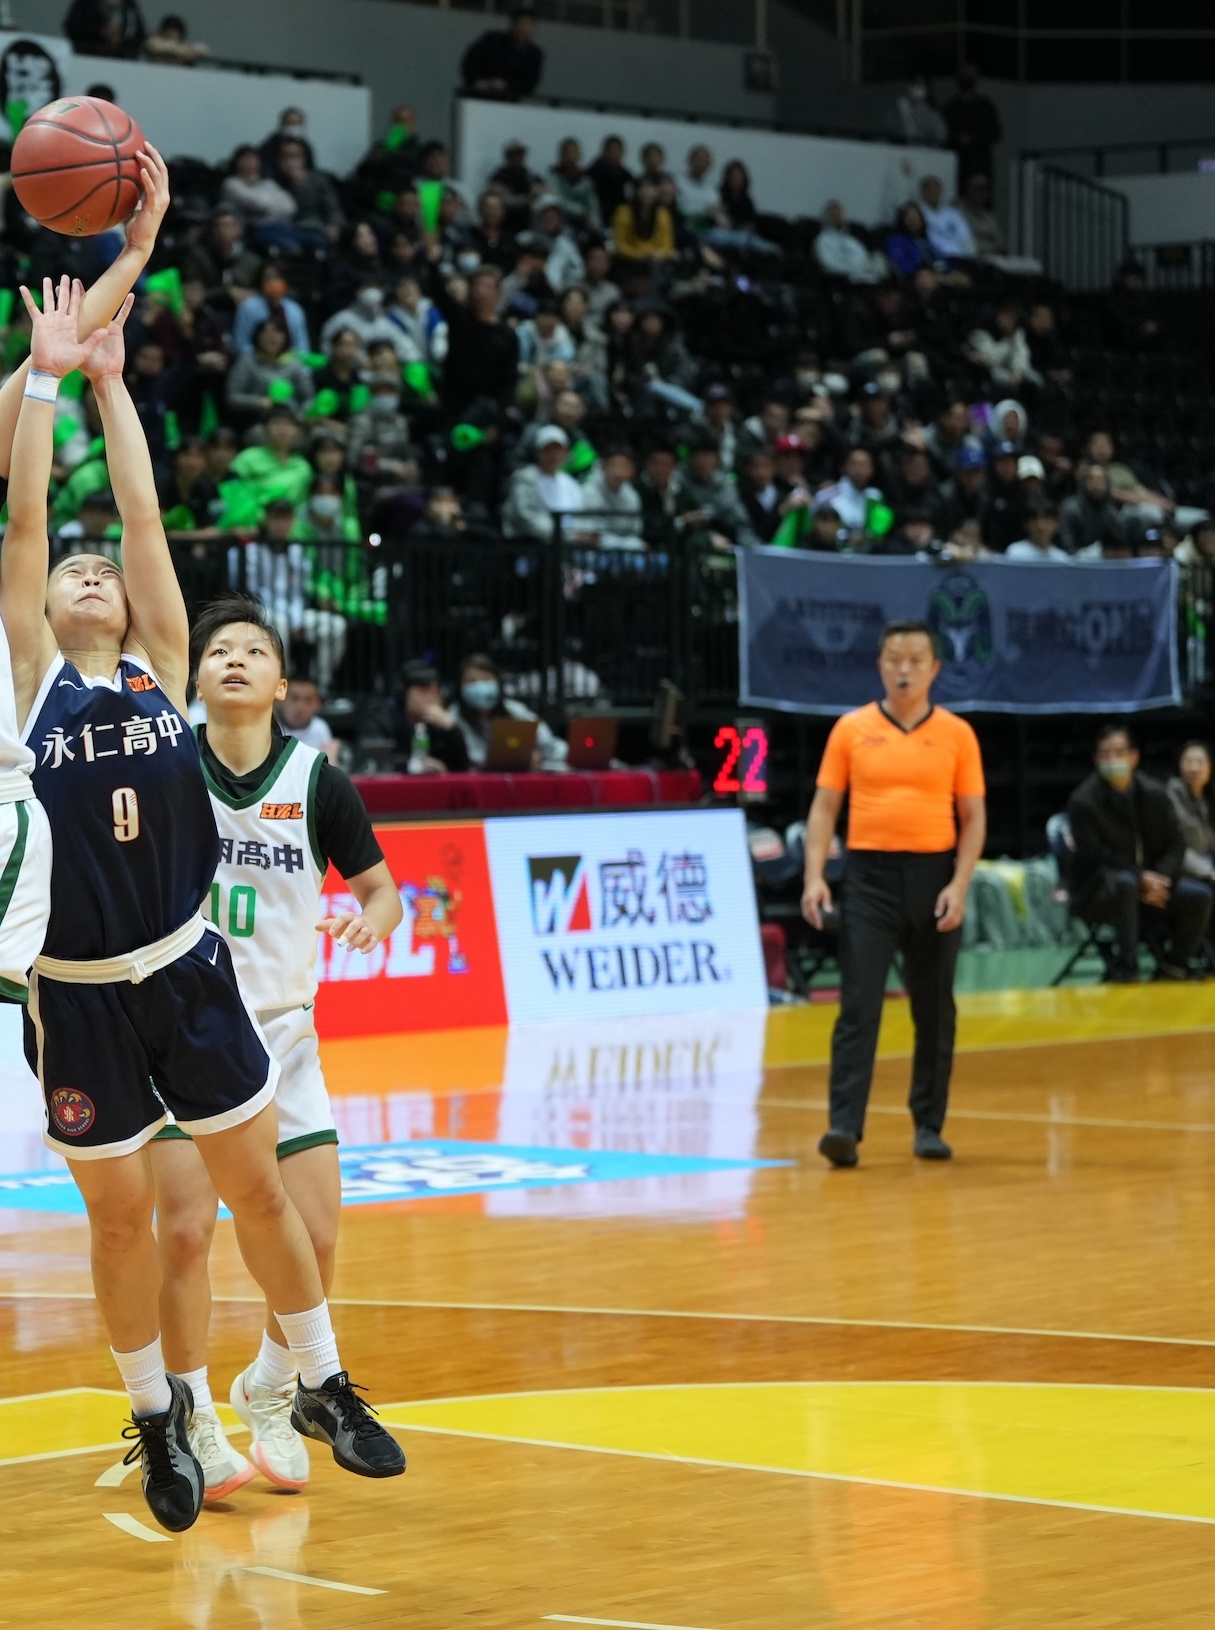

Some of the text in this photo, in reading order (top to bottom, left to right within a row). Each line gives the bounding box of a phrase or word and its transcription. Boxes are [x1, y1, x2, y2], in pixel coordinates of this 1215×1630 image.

[41, 710, 183, 769] 永仁高中
[111, 786, 140, 843] 9
[259, 802, 304, 820] HBL
[209, 882, 257, 938] 10
[599, 848, 716, 929] 威德
[542, 938, 722, 993] WEIDER
